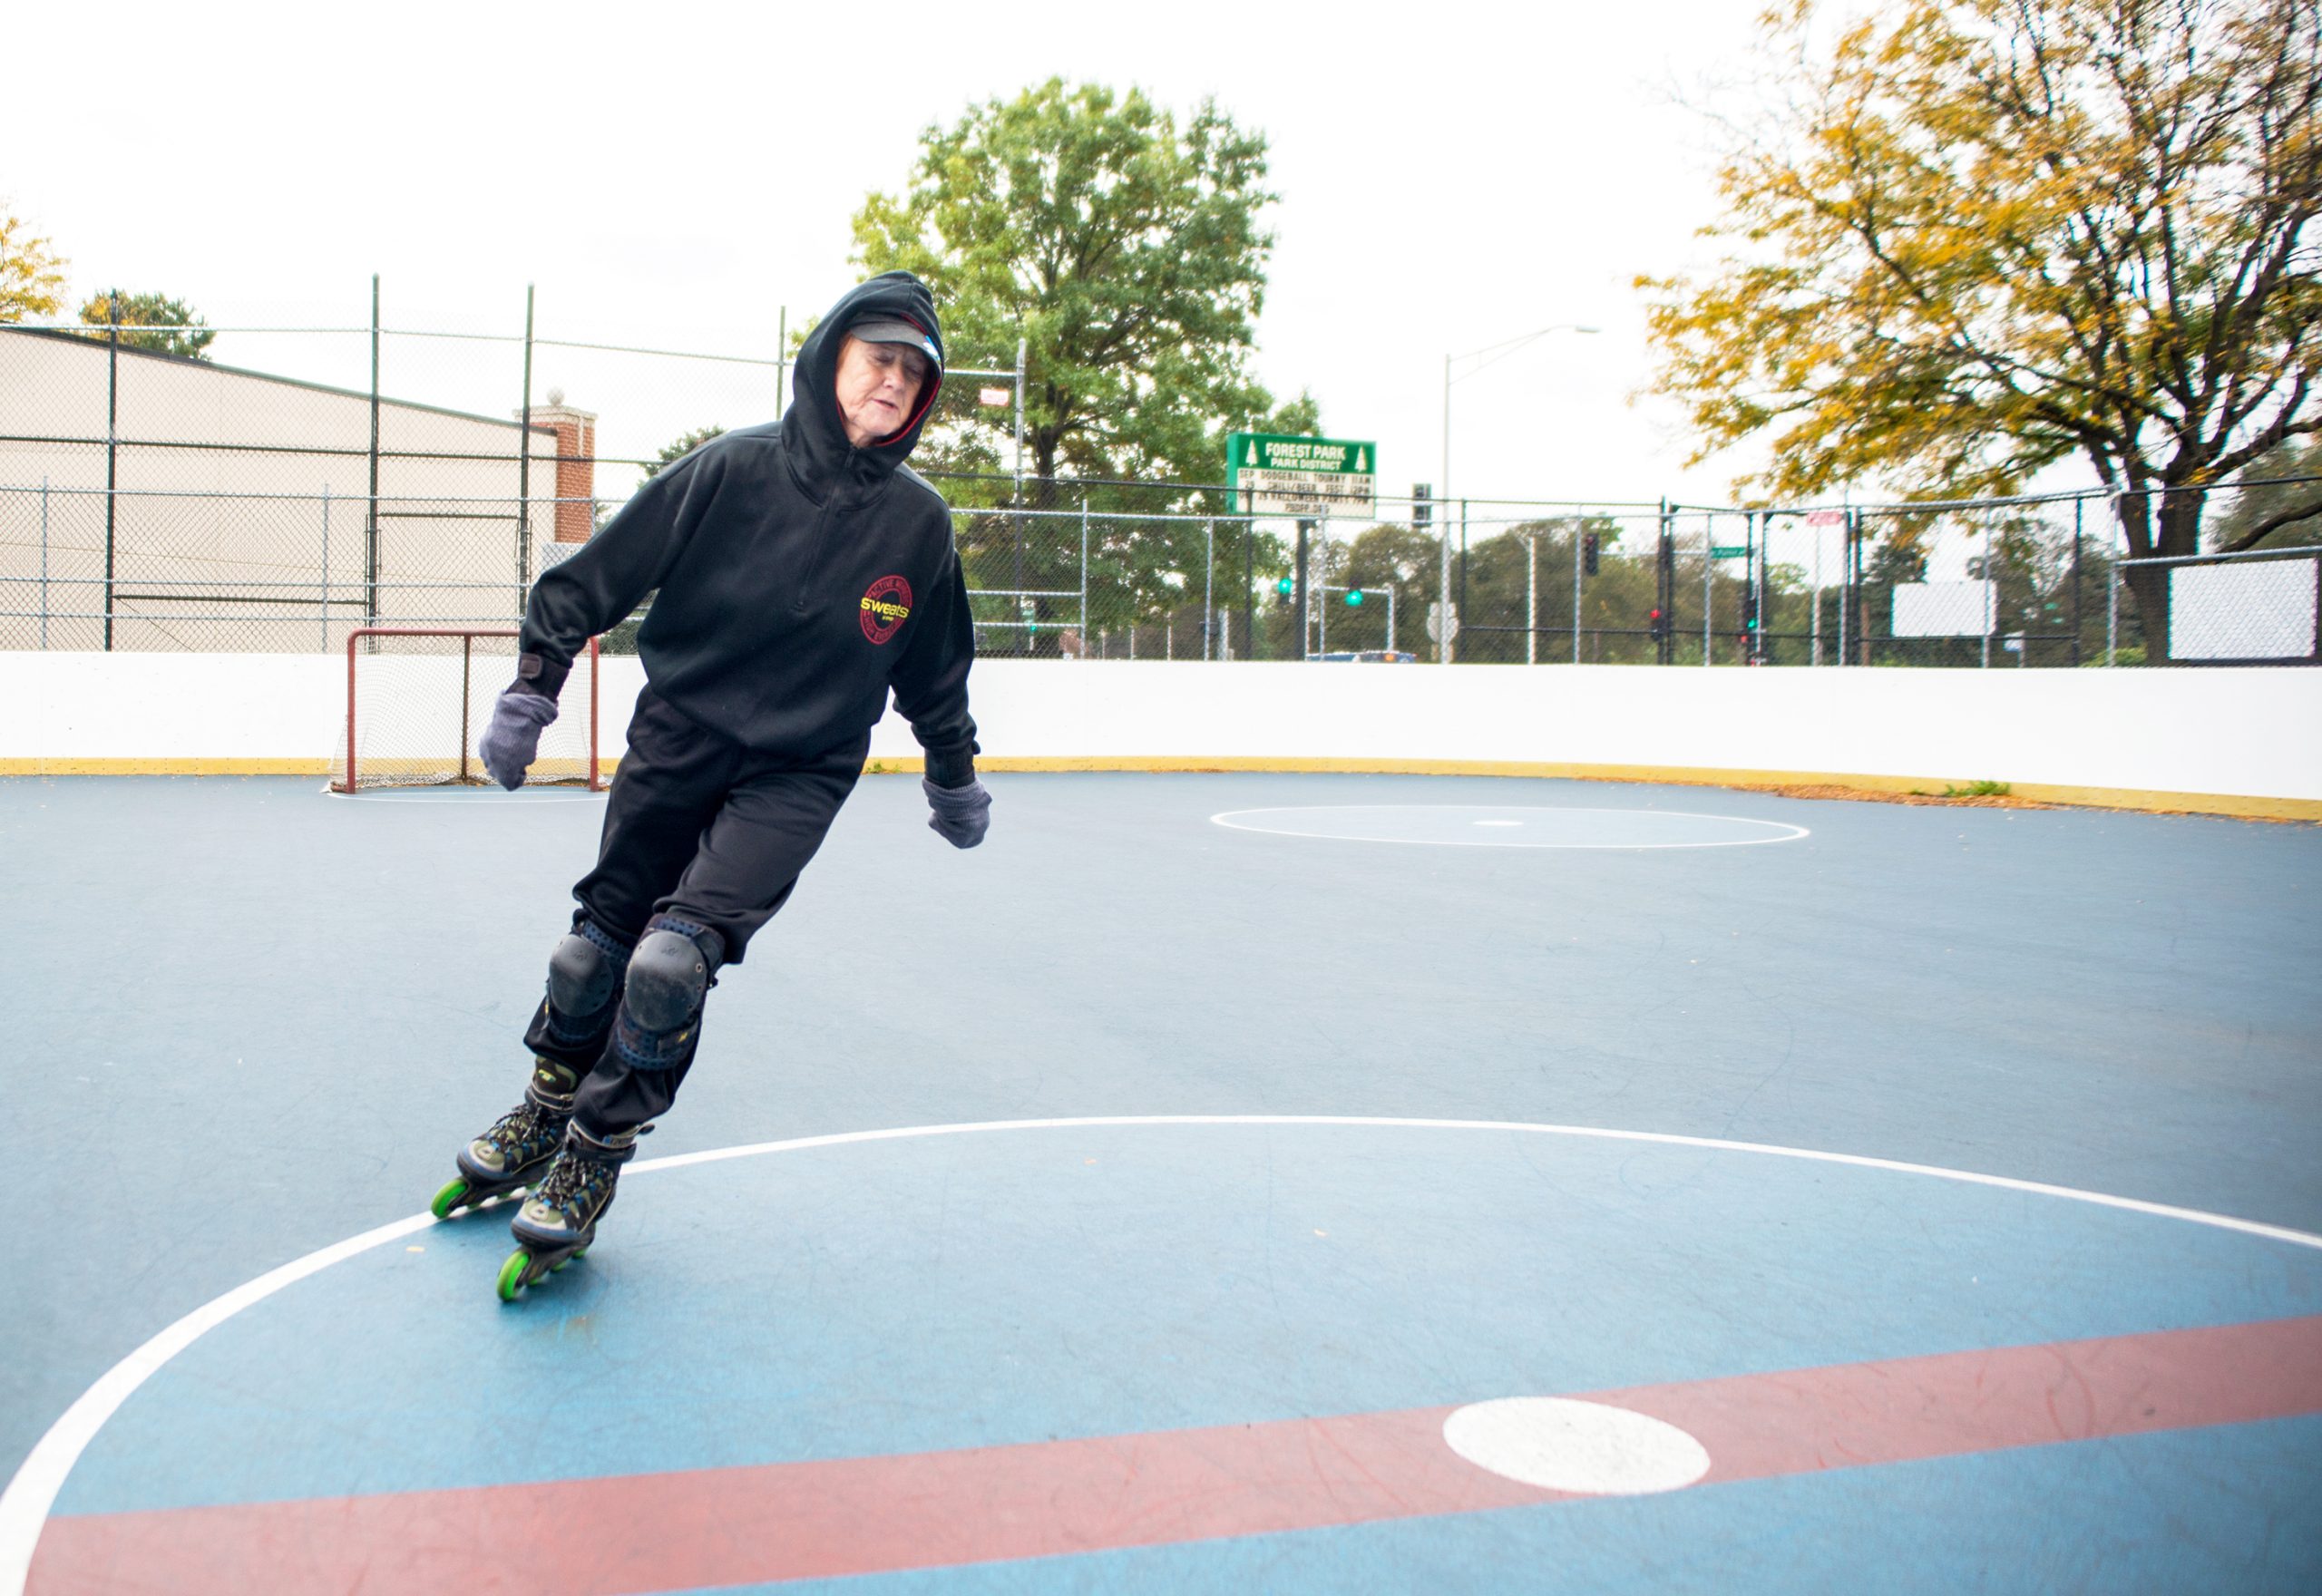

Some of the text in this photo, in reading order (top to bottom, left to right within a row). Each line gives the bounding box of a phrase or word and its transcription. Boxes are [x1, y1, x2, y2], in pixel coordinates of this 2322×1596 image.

[1265, 443, 1347, 461] FOREST PARK
[1271, 458, 1342, 471] PARK DISTRICT
